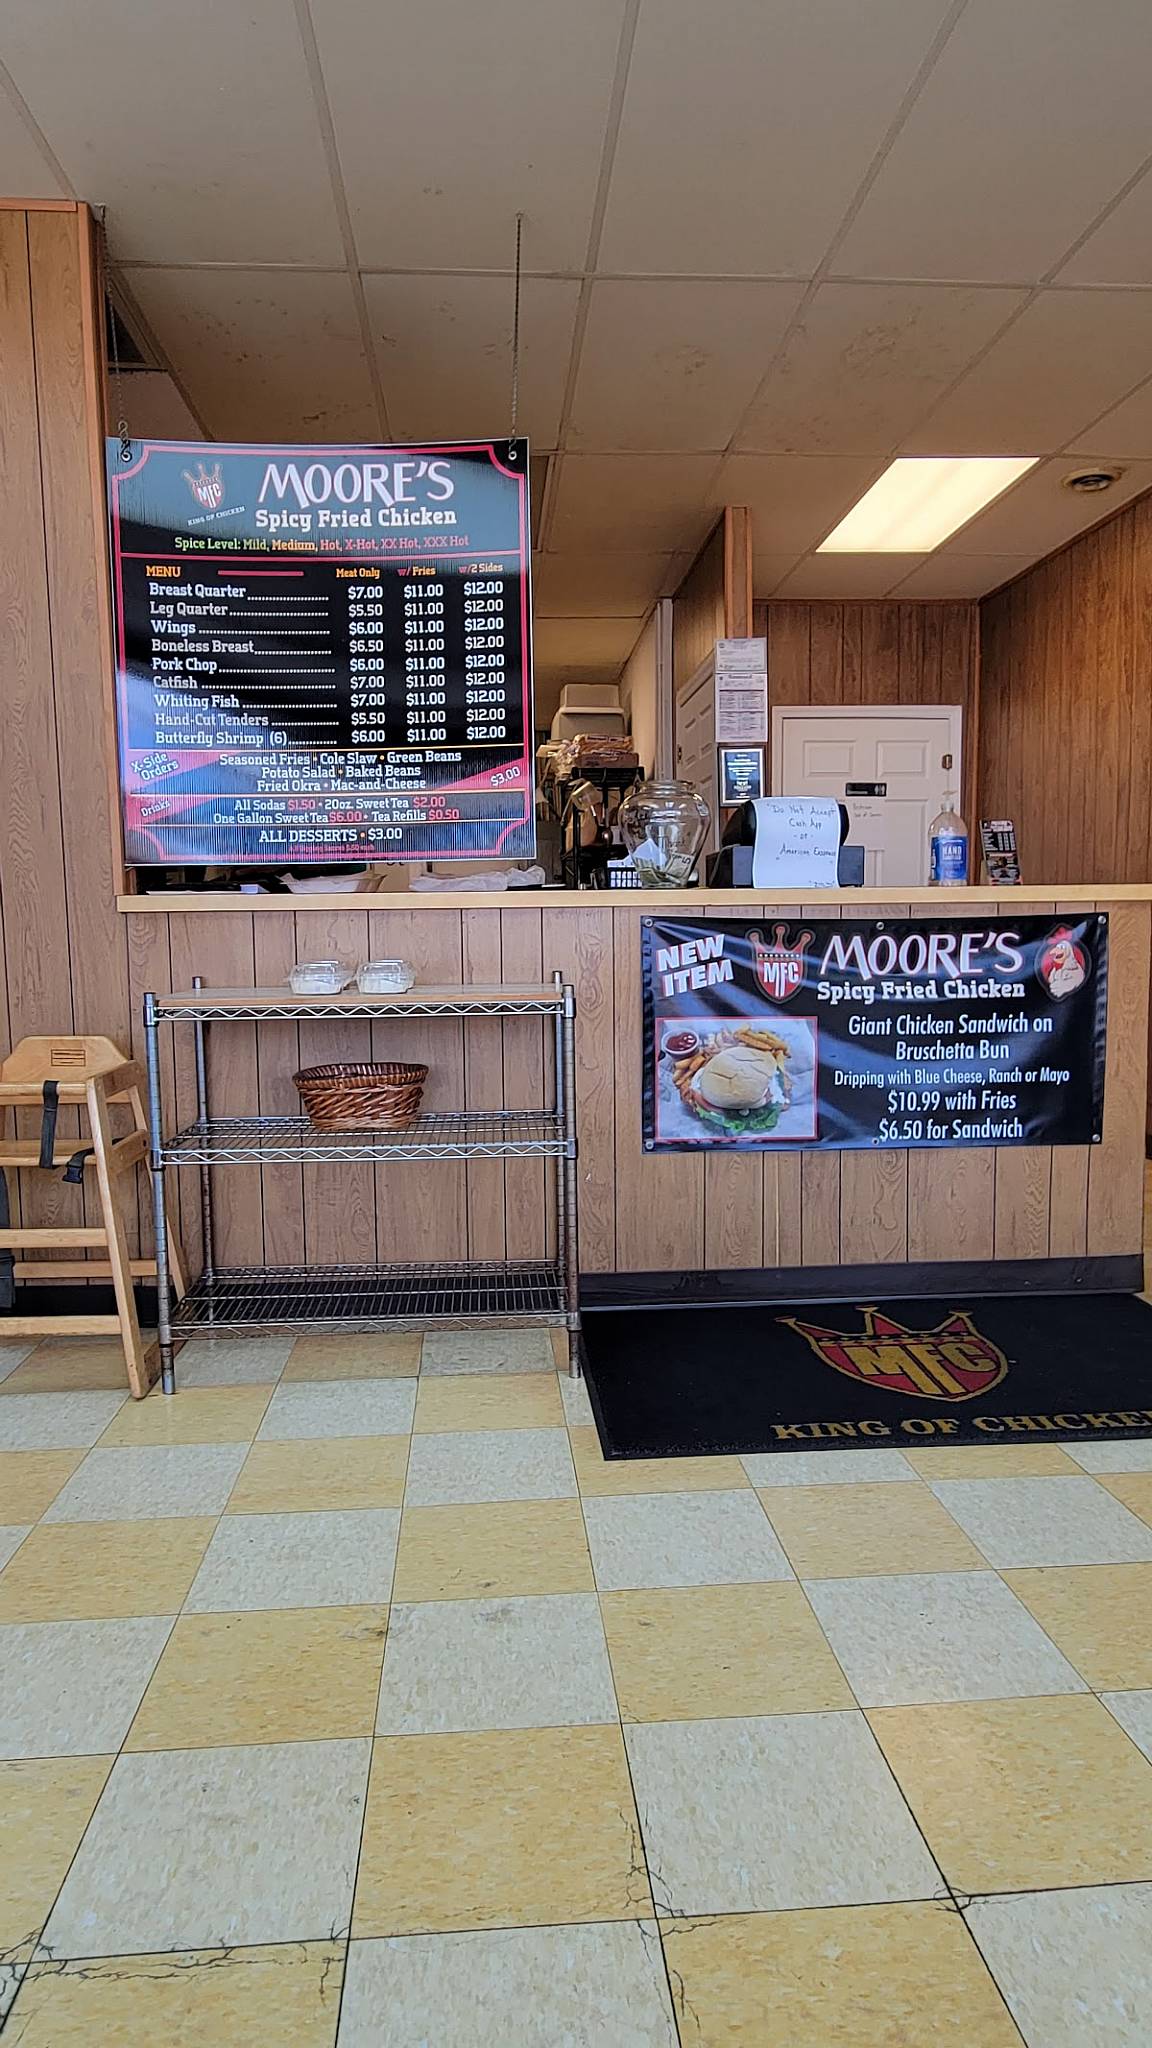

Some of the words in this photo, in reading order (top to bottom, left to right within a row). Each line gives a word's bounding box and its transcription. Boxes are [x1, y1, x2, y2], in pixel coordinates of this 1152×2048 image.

[258, 461, 455, 509] MOORE'S
[198, 483, 221, 508] MFC
[216, 506, 245, 519] CHICKEN
[256, 510, 312, 532] Spicy
[318, 507, 372, 527] Fried
[378, 507, 456, 526] Chicken
[175, 537, 206, 551] Spice
[208, 538, 241, 549] Level:
[243, 539, 269, 551] Mild,
[272, 539, 318, 552] Medium,
[320, 540, 342, 551] Hot,
[345, 539, 378, 550] X-Hot,
[381, 539, 397, 549] XX
[399, 538, 421, 549] Hot,
[424, 536, 447, 547] XXX
[450, 535, 469, 546] Hot
[146, 565, 181, 577] MENU
[336, 568, 357, 578] Meat
[359, 567, 380, 579] Only
[397, 568, 411, 577] w/
[412, 566, 435, 576] Fries
[478, 563, 503, 573] Sides
[150, 583, 192, 596] Breast
[195, 584, 246, 598] Quarter
[348, 586, 383, 600] $7.00
[404, 584, 444, 598] $11.00
[464, 581, 503, 596] $12.00
[150, 601, 174, 618] Leg
[177, 603, 228, 617] Quarter
[349, 604, 383, 618] $5.50
[404, 602, 444, 616] $11.00
[464, 599, 504, 614] $12.00
[151, 620, 196, 637] Wings
[349, 622, 384, 636] $6.00
[405, 620, 444, 634] $11.00
[464, 617, 504, 632] $12.00
[152, 639, 210, 653] Boneless
[212, 641, 254, 653] Breast
[349, 640, 384, 654] $6.50
[405, 638, 444, 653] $11.00
[465, 635, 504, 650] $12.00
[152, 657, 183, 671] Pork
[185, 658, 217, 674] Chop
[350, 658, 384, 672] $6.00
[406, 657, 445, 671] $11.00
[465, 654, 505, 669] $12.00
[153, 676, 198, 689] Catfish
[350, 676, 385, 690] $7.00
[406, 674, 445, 689] $11.00
[465, 671, 505, 687] $12.00
[154, 694, 209, 710] Whiting
[211, 694, 240, 708] Fish
[350, 693, 385, 708] $7.00
[406, 692, 446, 706] $11.00
[466, 689, 505, 705] $12.00
[155, 714, 216, 726] Hand-Cut
[218, 713, 269, 726] Tenders
[351, 712, 385, 726] $5.50
[407, 711, 446, 725] $11.00
[466, 708, 505, 723] $12.00
[155, 731, 213, 747] Butterfly
[216, 732, 263, 747] Shrimp
[270, 731, 287, 746] (6)
[352, 730, 385, 744] $6.00
[407, 729, 446, 743] $11.00
[467, 726, 506, 740] $12.00
[131, 752, 168, 772] X-Side
[220, 754, 277, 766] Seasoned
[279, 754, 310, 765] Fries
[320, 752, 345, 765] Cole
[347, 752, 377, 765] Slaw
[387, 752, 423, 763] Green
[425, 751, 462, 762] Beans
[140, 760, 179, 781] Orders
[262, 767, 300, 779] Potato
[302, 767, 336, 779] Salad
[346, 765, 383, 777] Baked
[385, 765, 421, 777] Beans
[490, 766, 521, 787] $3.00
[257, 780, 290, 792] Fried
[292, 780, 321, 791] Okra
[331, 778, 426, 791] Mac-and-Cheese
[141, 800, 171, 817] Drinks
[235, 800, 251, 811] All
[253, 800, 286, 810] Sodas
[287, 799, 316, 811] $1.50
[355, 798, 389, 809] Sweet
[390, 797, 409, 808] Tea
[413, 796, 446, 808] $2.00
[214, 813, 235, 824] One
[237, 812, 273, 824] Gallon
[275, 812, 309, 823] Sweet
[311, 812, 329, 823] Tea
[329, 811, 363, 823] $6.00
[372, 811, 391, 822] Tea
[392, 810, 426, 821] Refills
[428, 809, 460, 820] $0.50
[788, 819, 806, 828] Cash
[810, 818, 822, 830] App
[259, 830, 287, 842] ALL
[289, 829, 357, 842] DESSERTS
[368, 828, 403, 840] $3.00
[943, 845, 962, 856] HAND
[656, 933, 725, 972] NEW
[820, 931, 1024, 981] MOORE'S
[662, 959, 734, 997] ITEM
[763, 961, 799, 997] MFC
[817, 981, 875, 1005] Spicy
[881, 979, 938, 999] Fried
[943, 978, 1025, 999] Chicken
[849, 1016, 892, 1035] Giant
[896, 1014, 954, 1035] Chicken
[958, 1012, 1028, 1033] Sandwich
[1033, 1017, 1053, 1032] on
[896, 1039, 974, 1060] Bruschetta
[979, 1040, 1009, 1059] Bun
[834, 1070, 884, 1089] Dripping
[888, 1070, 911, 1085] with
[915, 1069, 940, 1084] Blue
[943, 1068, 986, 1086] Cheese,
[989, 1067, 1022, 1083] Ranch
[1024, 1070, 1038, 1082] or
[1040, 1067, 1070, 1085] Mayo
[887, 1090, 940, 1113] $10.99
[944, 1090, 977, 1110] with
[981, 1090, 1016, 1109] Fries
[879, 1118, 922, 1142] $6.50
[926, 1118, 949, 1139] for
[952, 1117, 1023, 1138] Sandwich
[842, 1343, 998, 1396] MFC
[769, 1419, 892, 1440] KING
[899, 1418, 961, 1435] OF
